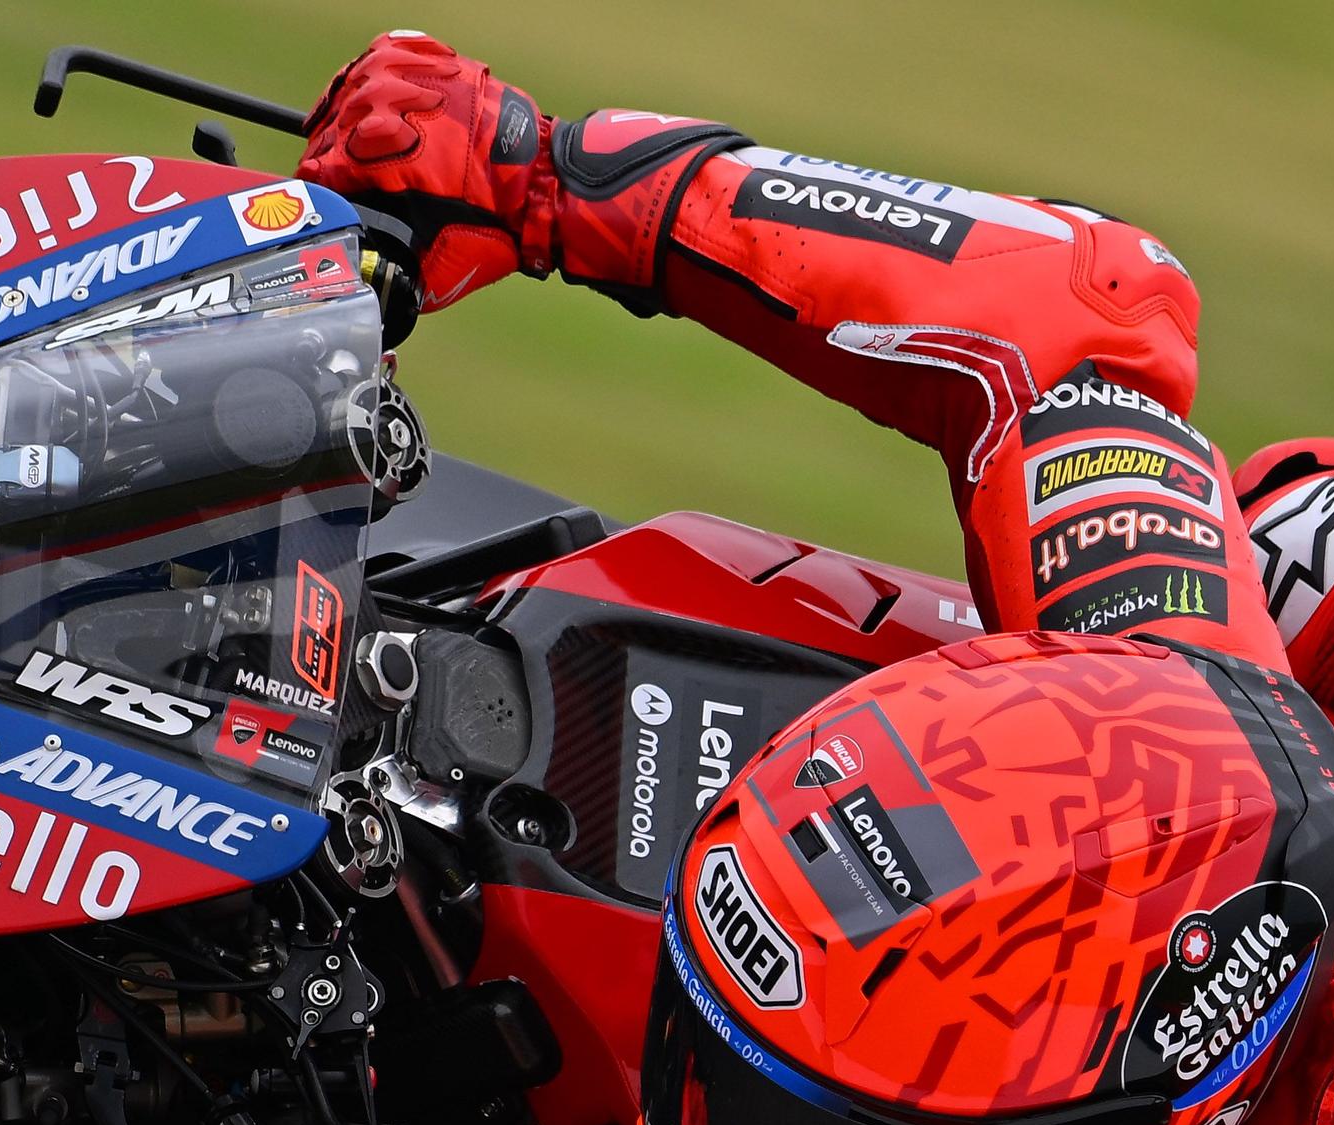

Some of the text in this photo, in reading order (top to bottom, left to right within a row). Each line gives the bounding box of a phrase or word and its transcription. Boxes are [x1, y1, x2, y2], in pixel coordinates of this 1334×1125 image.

[760, 178, 952, 246] Lenovo
[254, 273, 304, 290] Lenovo
[1037, 508, 1221, 583] aruba.it
[1063, 586, 1140, 626] ENERGY
[14, 651, 211, 736] WRS
[236, 668, 336, 717] MARQUEZ
[267, 733, 316, 759] Lenovo
[829, 739, 858, 772] DUCATI
[629, 727, 660, 859] motorola
[843, 796, 912, 898] Lenovo
[837, 853, 884, 917] FACTORY TEAM
[700, 861, 789, 996] SHOEI
[665, 913, 689, 985] Estrella
[688, 978, 732, 1042] Galicia
[1151, 913, 1290, 1063] Estrella
[1176, 953, 1297, 1081] Galicia
